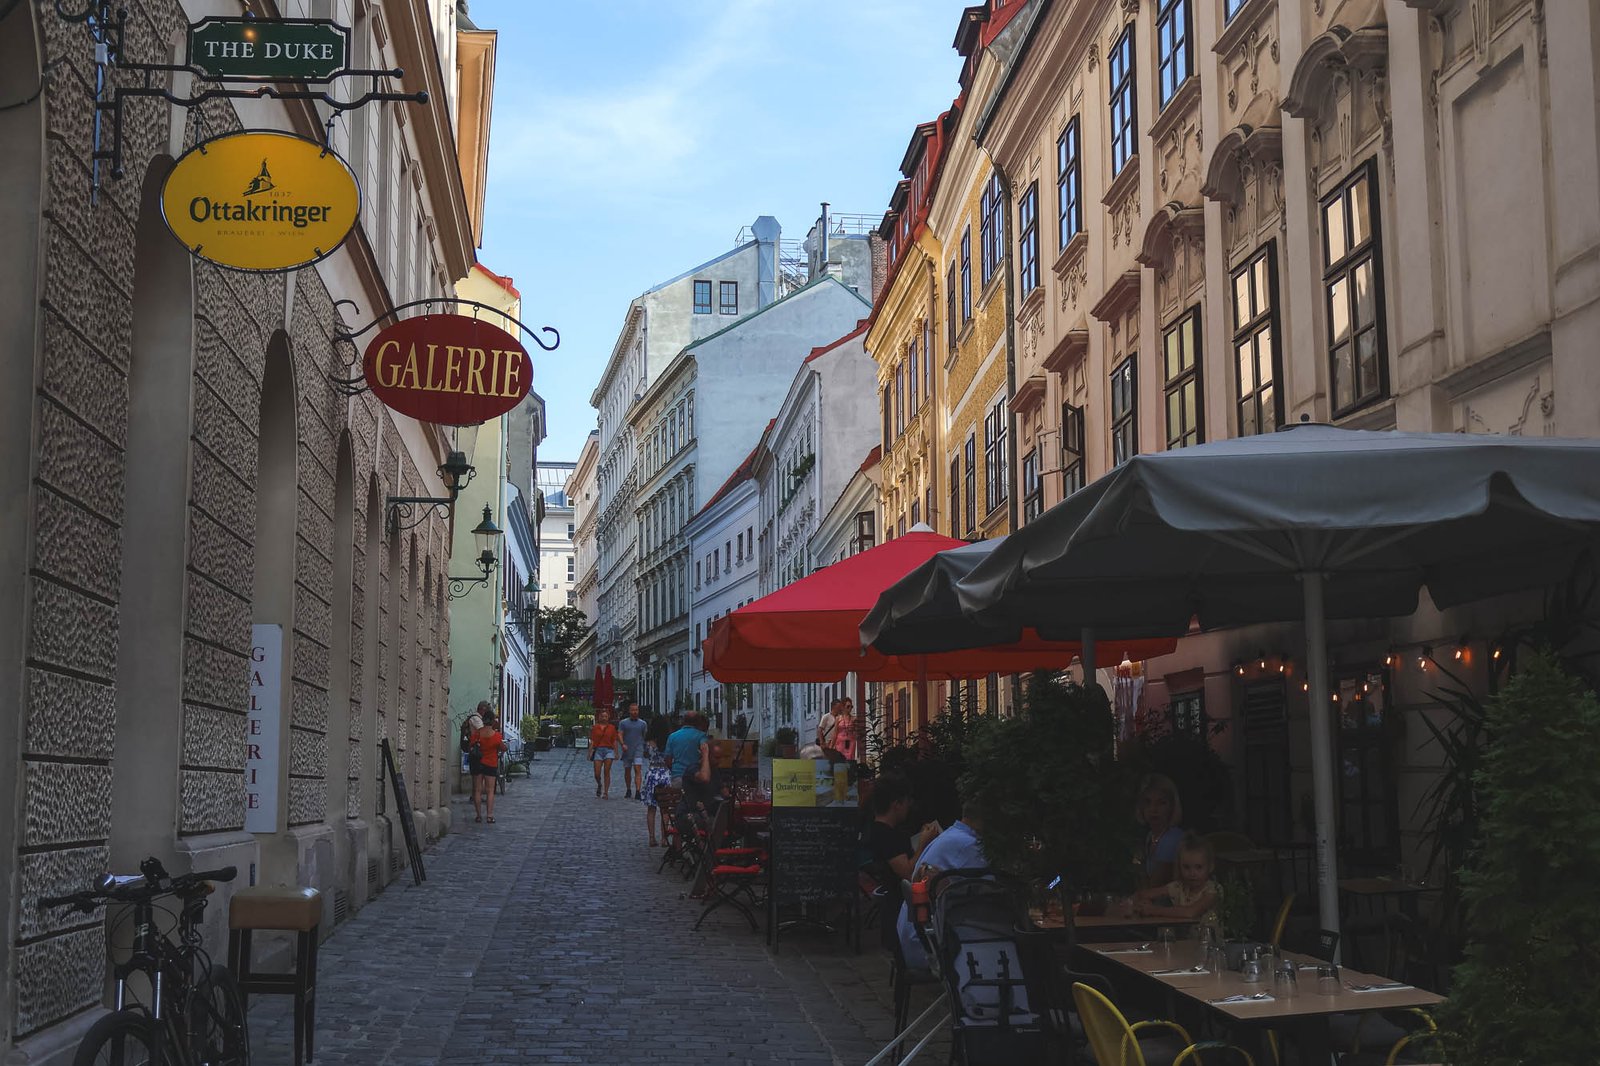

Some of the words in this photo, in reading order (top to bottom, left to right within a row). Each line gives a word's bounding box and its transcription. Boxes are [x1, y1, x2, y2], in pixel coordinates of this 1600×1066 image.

[204, 41, 255, 58] THE
[264, 42, 334, 60] DUKE
[189, 196, 332, 228] Ottakringer
[375, 340, 523, 398] GALERIE
[247, 646, 266, 809] GALERIE
